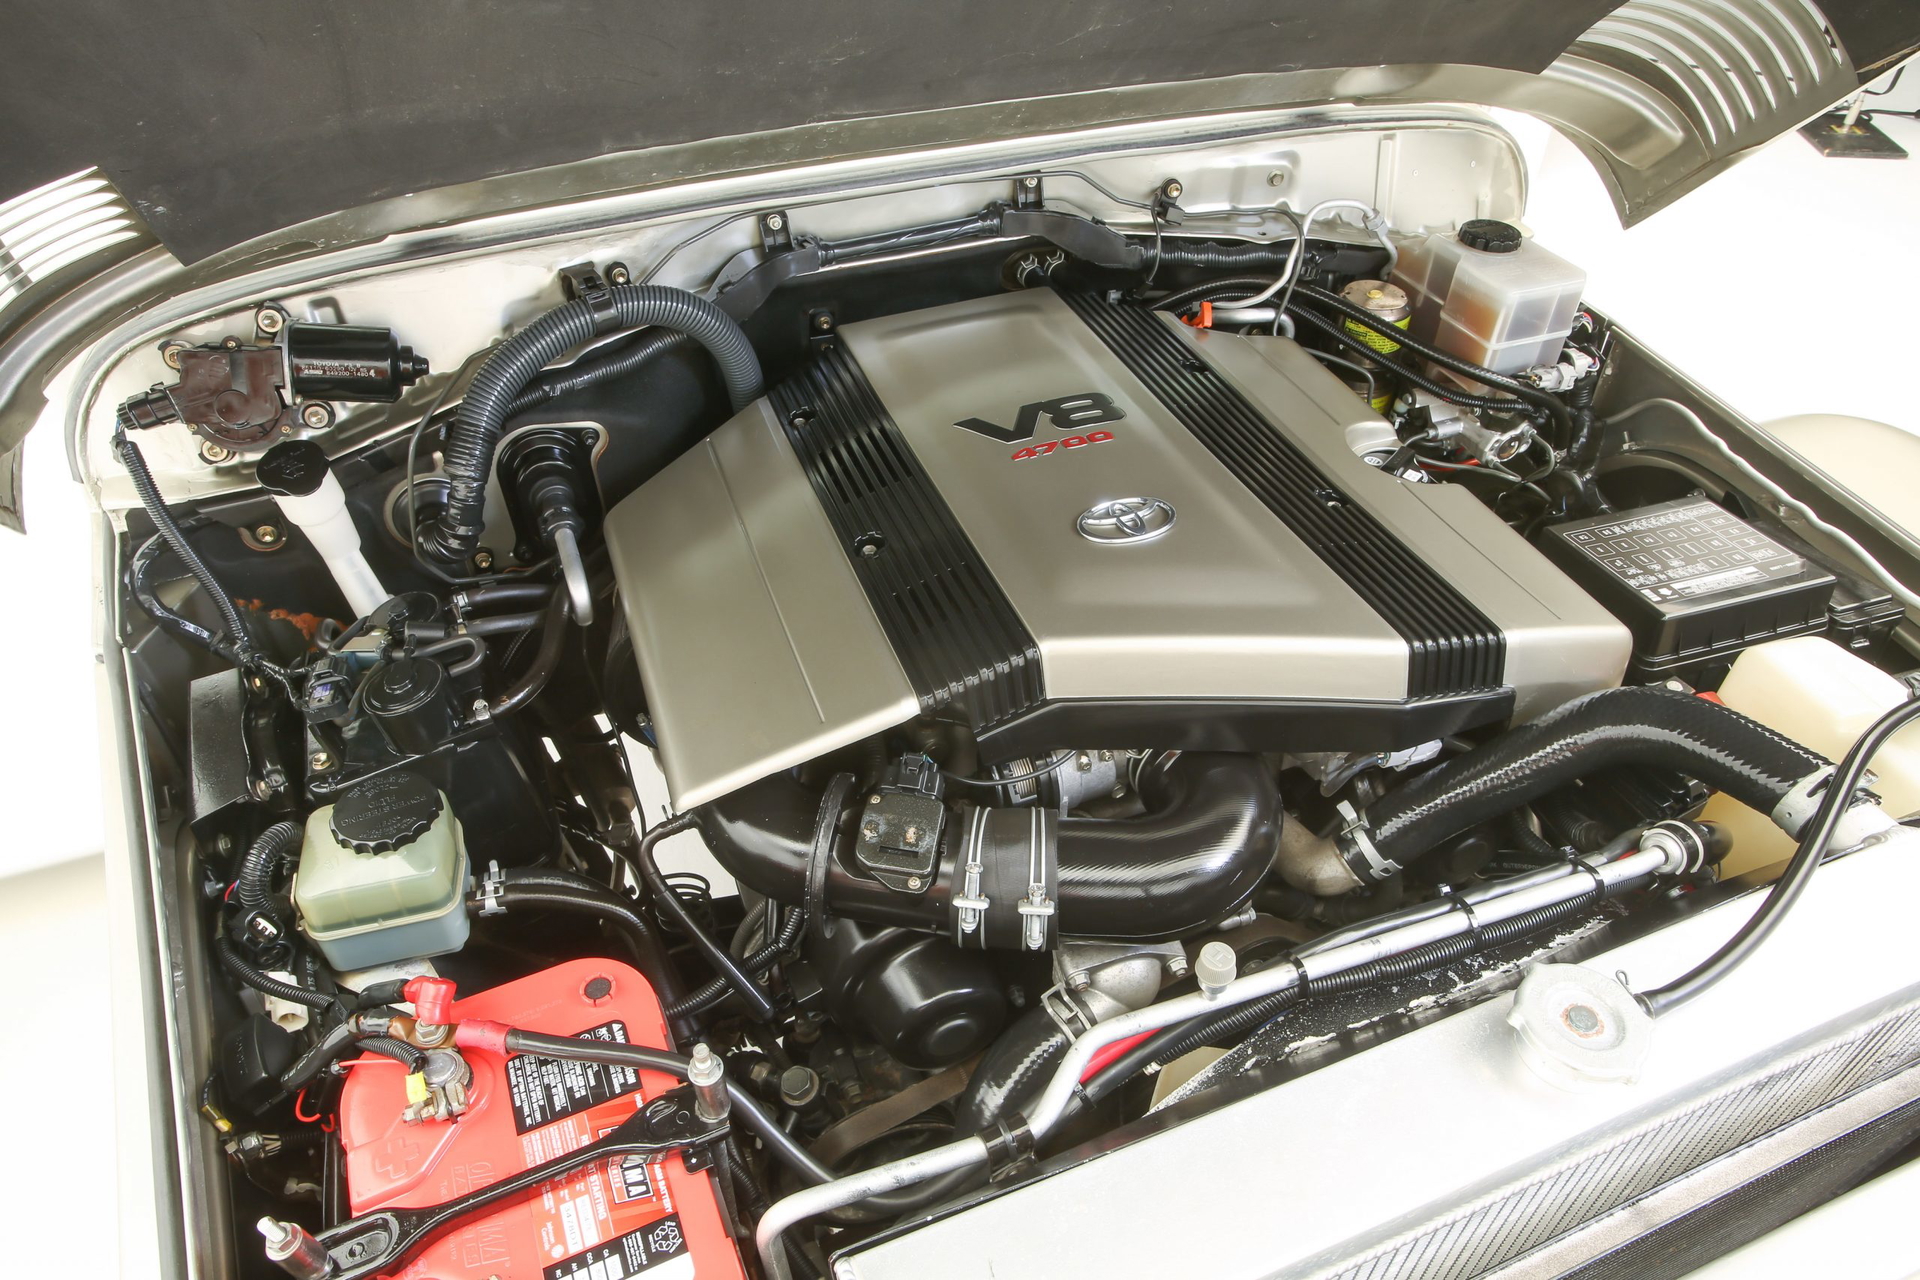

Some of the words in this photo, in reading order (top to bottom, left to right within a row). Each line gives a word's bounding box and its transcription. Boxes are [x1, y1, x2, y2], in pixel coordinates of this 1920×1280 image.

[952, 392, 1127, 444] V8
[1011, 431, 1116, 461] 4700
[368, 795, 396, 809] FLUID
[391, 794, 426, 810] POWER
[341, 805, 390, 826] STEERING
[653, 1164, 663, 1181] AGM
[590, 1174, 606, 1220] STARTING
[657, 1180, 673, 1213] BATTERY
[541, 1227, 549, 1251] Controls
[546, 1221, 555, 1243] Johnson
